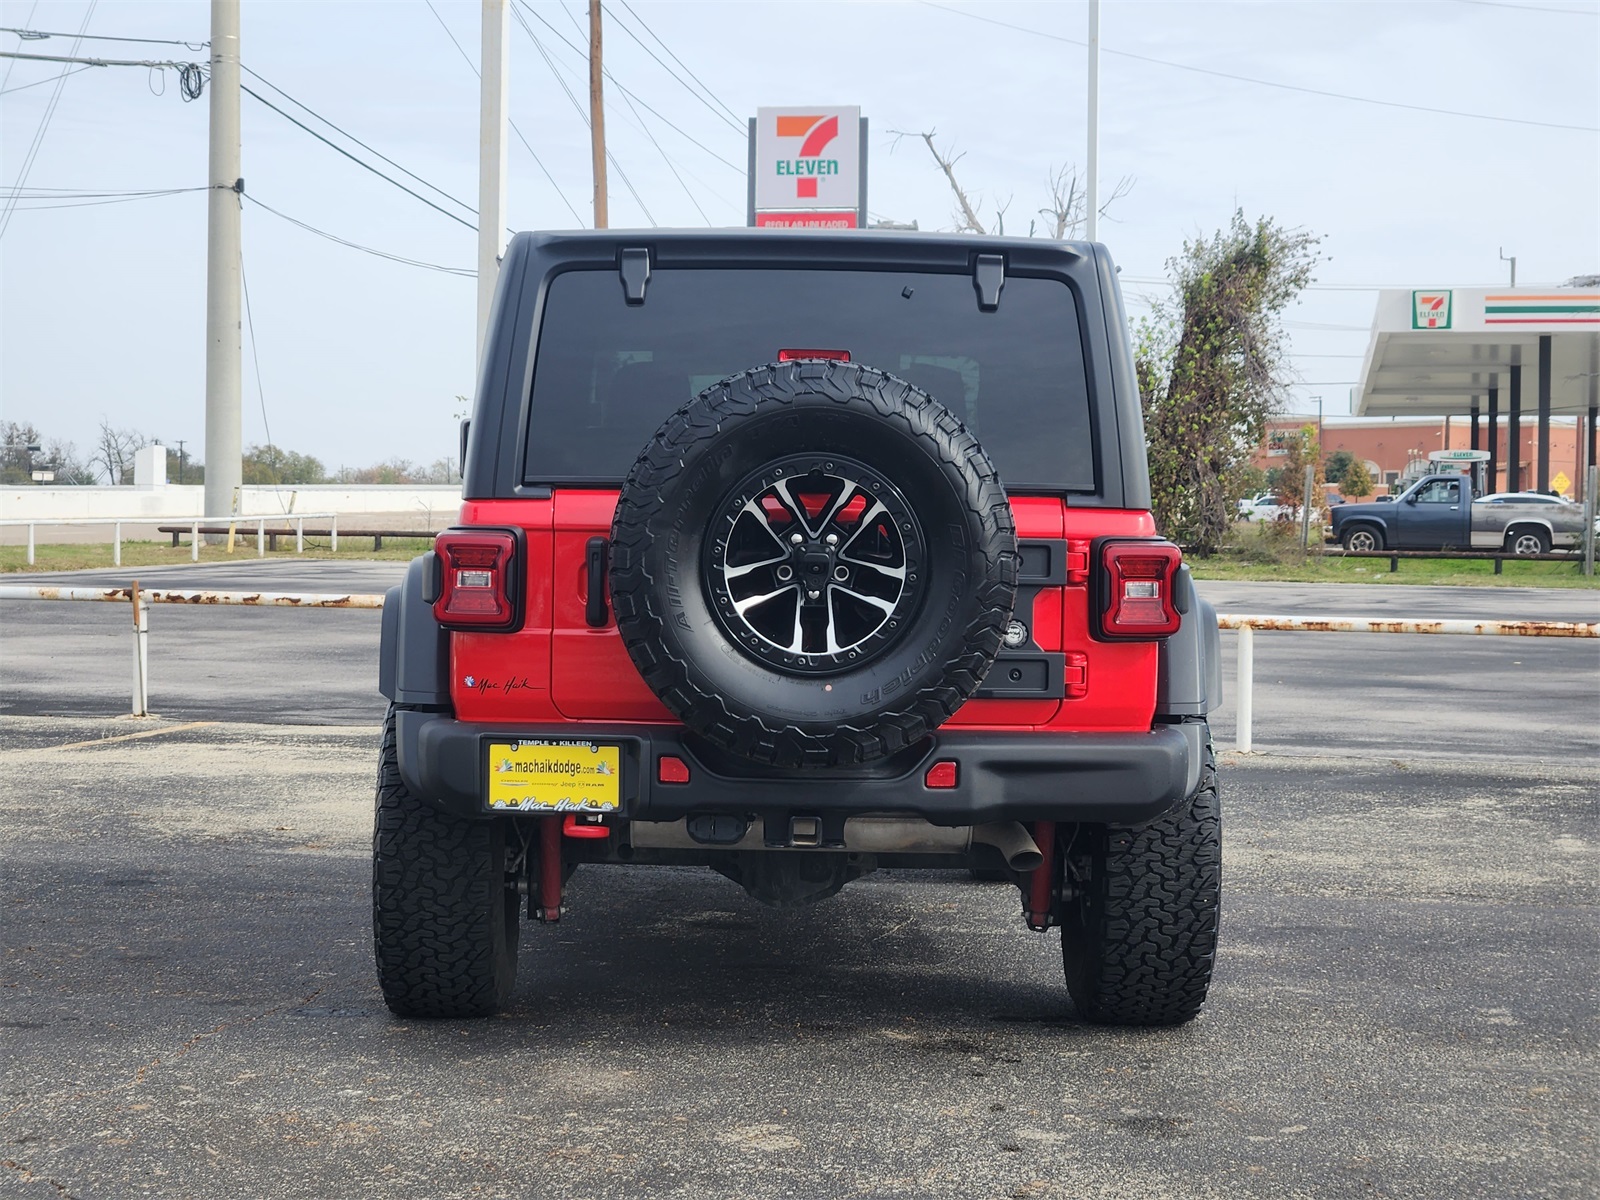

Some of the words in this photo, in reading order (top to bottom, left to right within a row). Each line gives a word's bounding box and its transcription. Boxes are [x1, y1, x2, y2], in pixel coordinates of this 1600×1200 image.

[476, 678, 500, 695] Mac
[503, 676, 545, 695] Haik
[515, 759, 595, 777] machaikdodge.com
[519, 796, 550, 811] Mac
[553, 797, 591, 811] Haik
